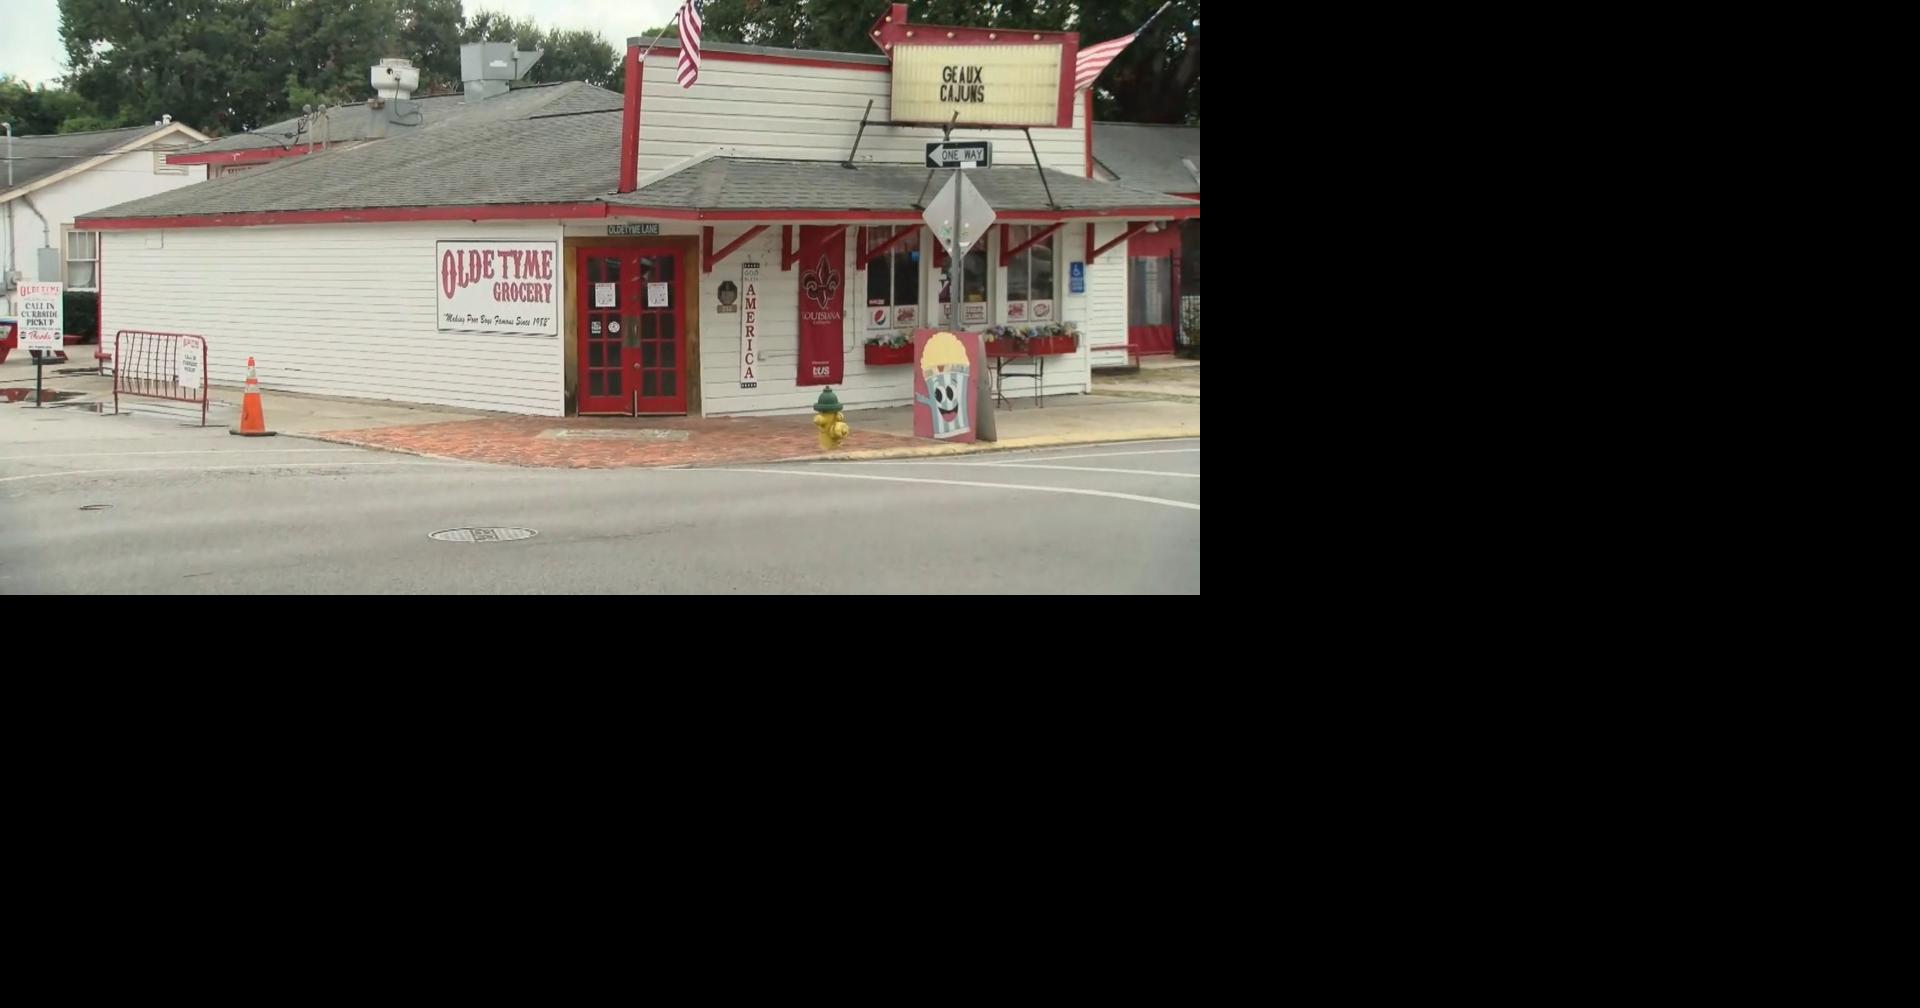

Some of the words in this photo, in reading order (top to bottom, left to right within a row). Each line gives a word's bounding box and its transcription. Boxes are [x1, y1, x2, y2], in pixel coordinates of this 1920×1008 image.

[942, 66, 983, 84] GEAUX
[940, 85, 985, 103] CAJUNS
[941, 150, 959, 161] ONE
[964, 149, 983, 160] WAY
[641, 223, 658, 234] LANE
[441, 248, 495, 300] OLDE
[497, 248, 553, 280] TYME
[493, 281, 553, 304] GROCERY
[25, 302, 44, 310] CALL
[46, 302, 55, 310] IN
[21, 310, 58, 318] CURBSIDE
[801, 311, 841, 320] LOUISIANA
[494, 315, 515, 326] Famous
[516, 316, 531, 327] Since
[744, 283, 757, 380] AMERICA
[812, 366, 830, 377] LUS
